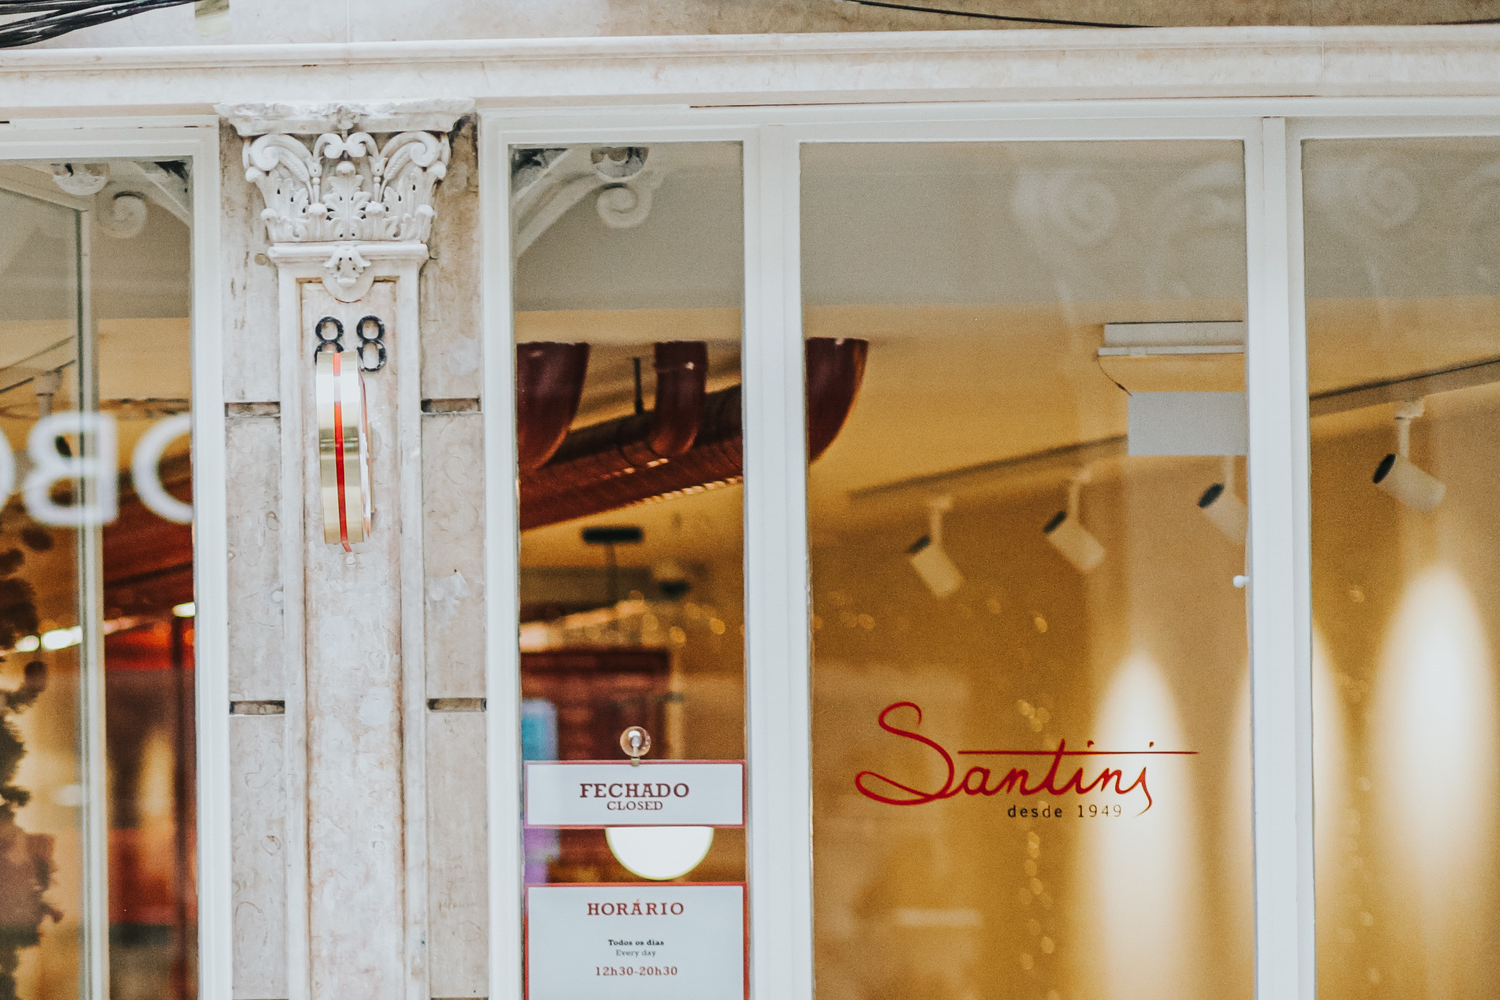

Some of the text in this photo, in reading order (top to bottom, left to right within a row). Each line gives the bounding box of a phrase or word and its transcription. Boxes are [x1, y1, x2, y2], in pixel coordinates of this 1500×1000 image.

[315, 315, 387, 372] 88
[855, 701, 1200, 818] Santini
[579, 782, 690, 799] FECHADO
[606, 801, 663, 811] CLOSED
[1007, 804, 1122, 818] desde 1949
[587, 898, 685, 916] HORÁRIO
[615, 949, 657, 957] Every day
[595, 966, 678, 976] 12h30-20h30
